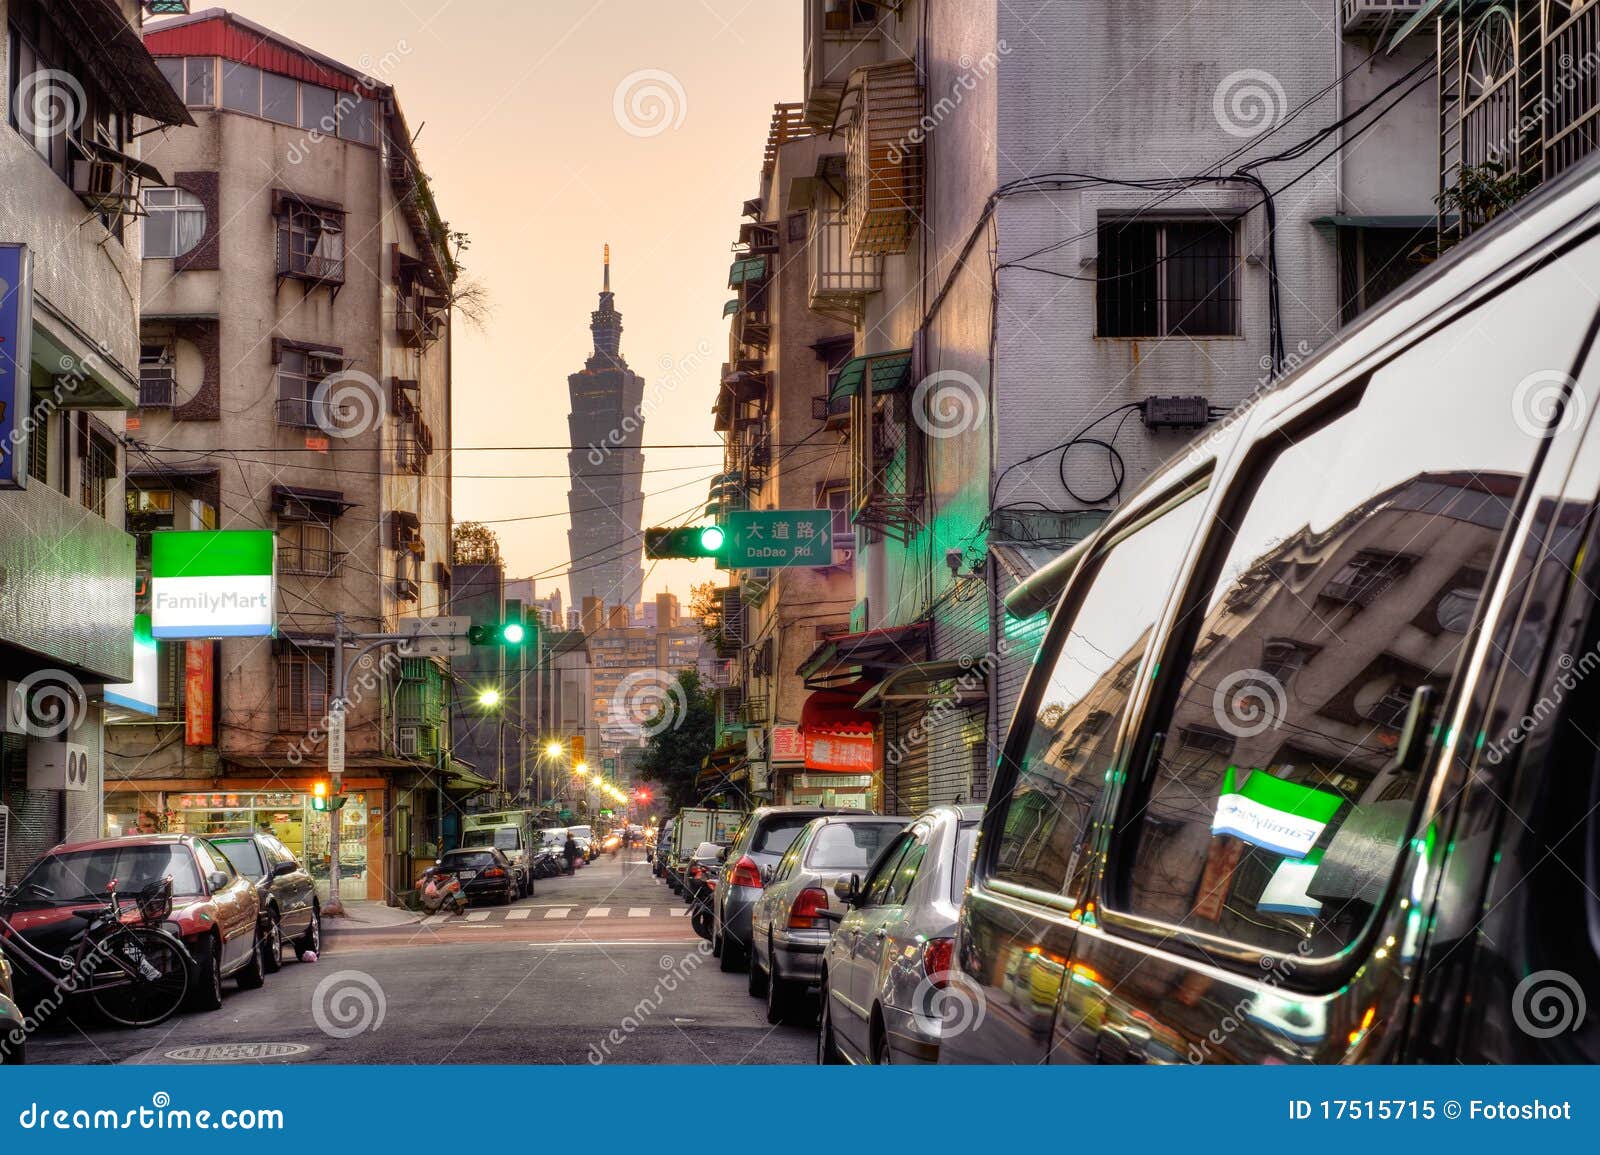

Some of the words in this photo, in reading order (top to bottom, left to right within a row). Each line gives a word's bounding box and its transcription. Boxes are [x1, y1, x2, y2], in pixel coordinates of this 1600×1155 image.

[746, 521, 815, 540] 大道路
[747, 547, 787, 558] DaDao
[794, 546, 814, 557] Rd.
[156, 591, 268, 613] FamilyMart
